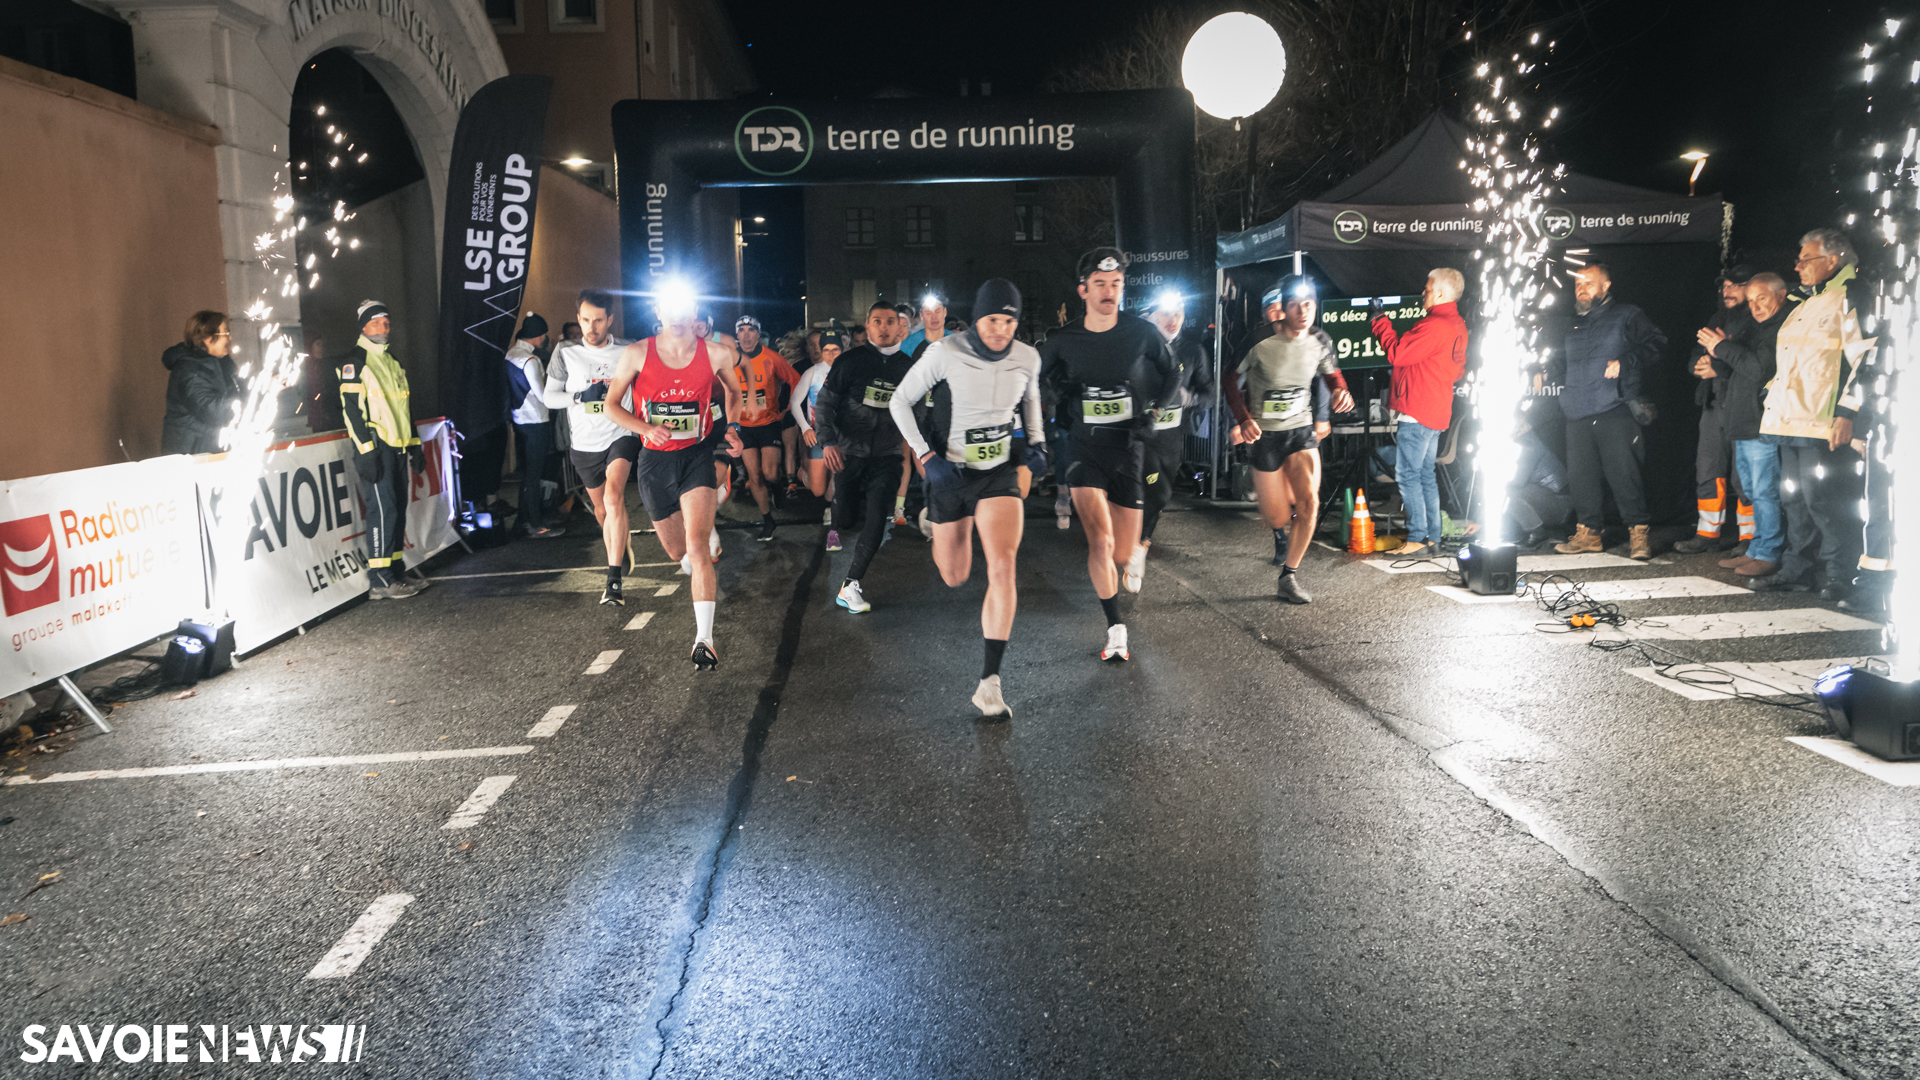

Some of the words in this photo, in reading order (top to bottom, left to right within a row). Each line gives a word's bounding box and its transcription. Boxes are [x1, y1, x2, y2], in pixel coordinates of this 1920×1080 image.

[744, 126, 805, 152] TDR
[827, 125, 900, 151] terre
[910, 121, 947, 149] de
[958, 118, 1075, 151] running
[472, 161, 483, 205] SOLUTIONS
[480, 182, 489, 199] VOS
[471, 205, 479, 221] DES
[478, 199, 487, 222] POUR
[496, 153, 533, 284] GROUP
[1580, 215, 1614, 228] terre
[1617, 213, 1635, 226] de
[1638, 211, 1690, 227] running
[642, 182, 667, 277] running
[1373, 220, 1406, 233] terre
[1409, 219, 1427, 232] de
[1430, 217, 1484, 233] running
[464, 228, 494, 291] LSE
[1124, 250, 1189, 263] Chaussures
[1124, 272, 1163, 287] Textile
[1322, 312, 1338, 323] 06
[1398, 307, 1428, 319] 2024
[660, 388, 695, 398] GRAC
[1093, 402, 1120, 415] 639
[209, 459, 353, 561] AVOIE
[60, 499, 177, 549] Radiance
[305, 564, 328, 594] LE
[12, 618, 64, 652] groupe
